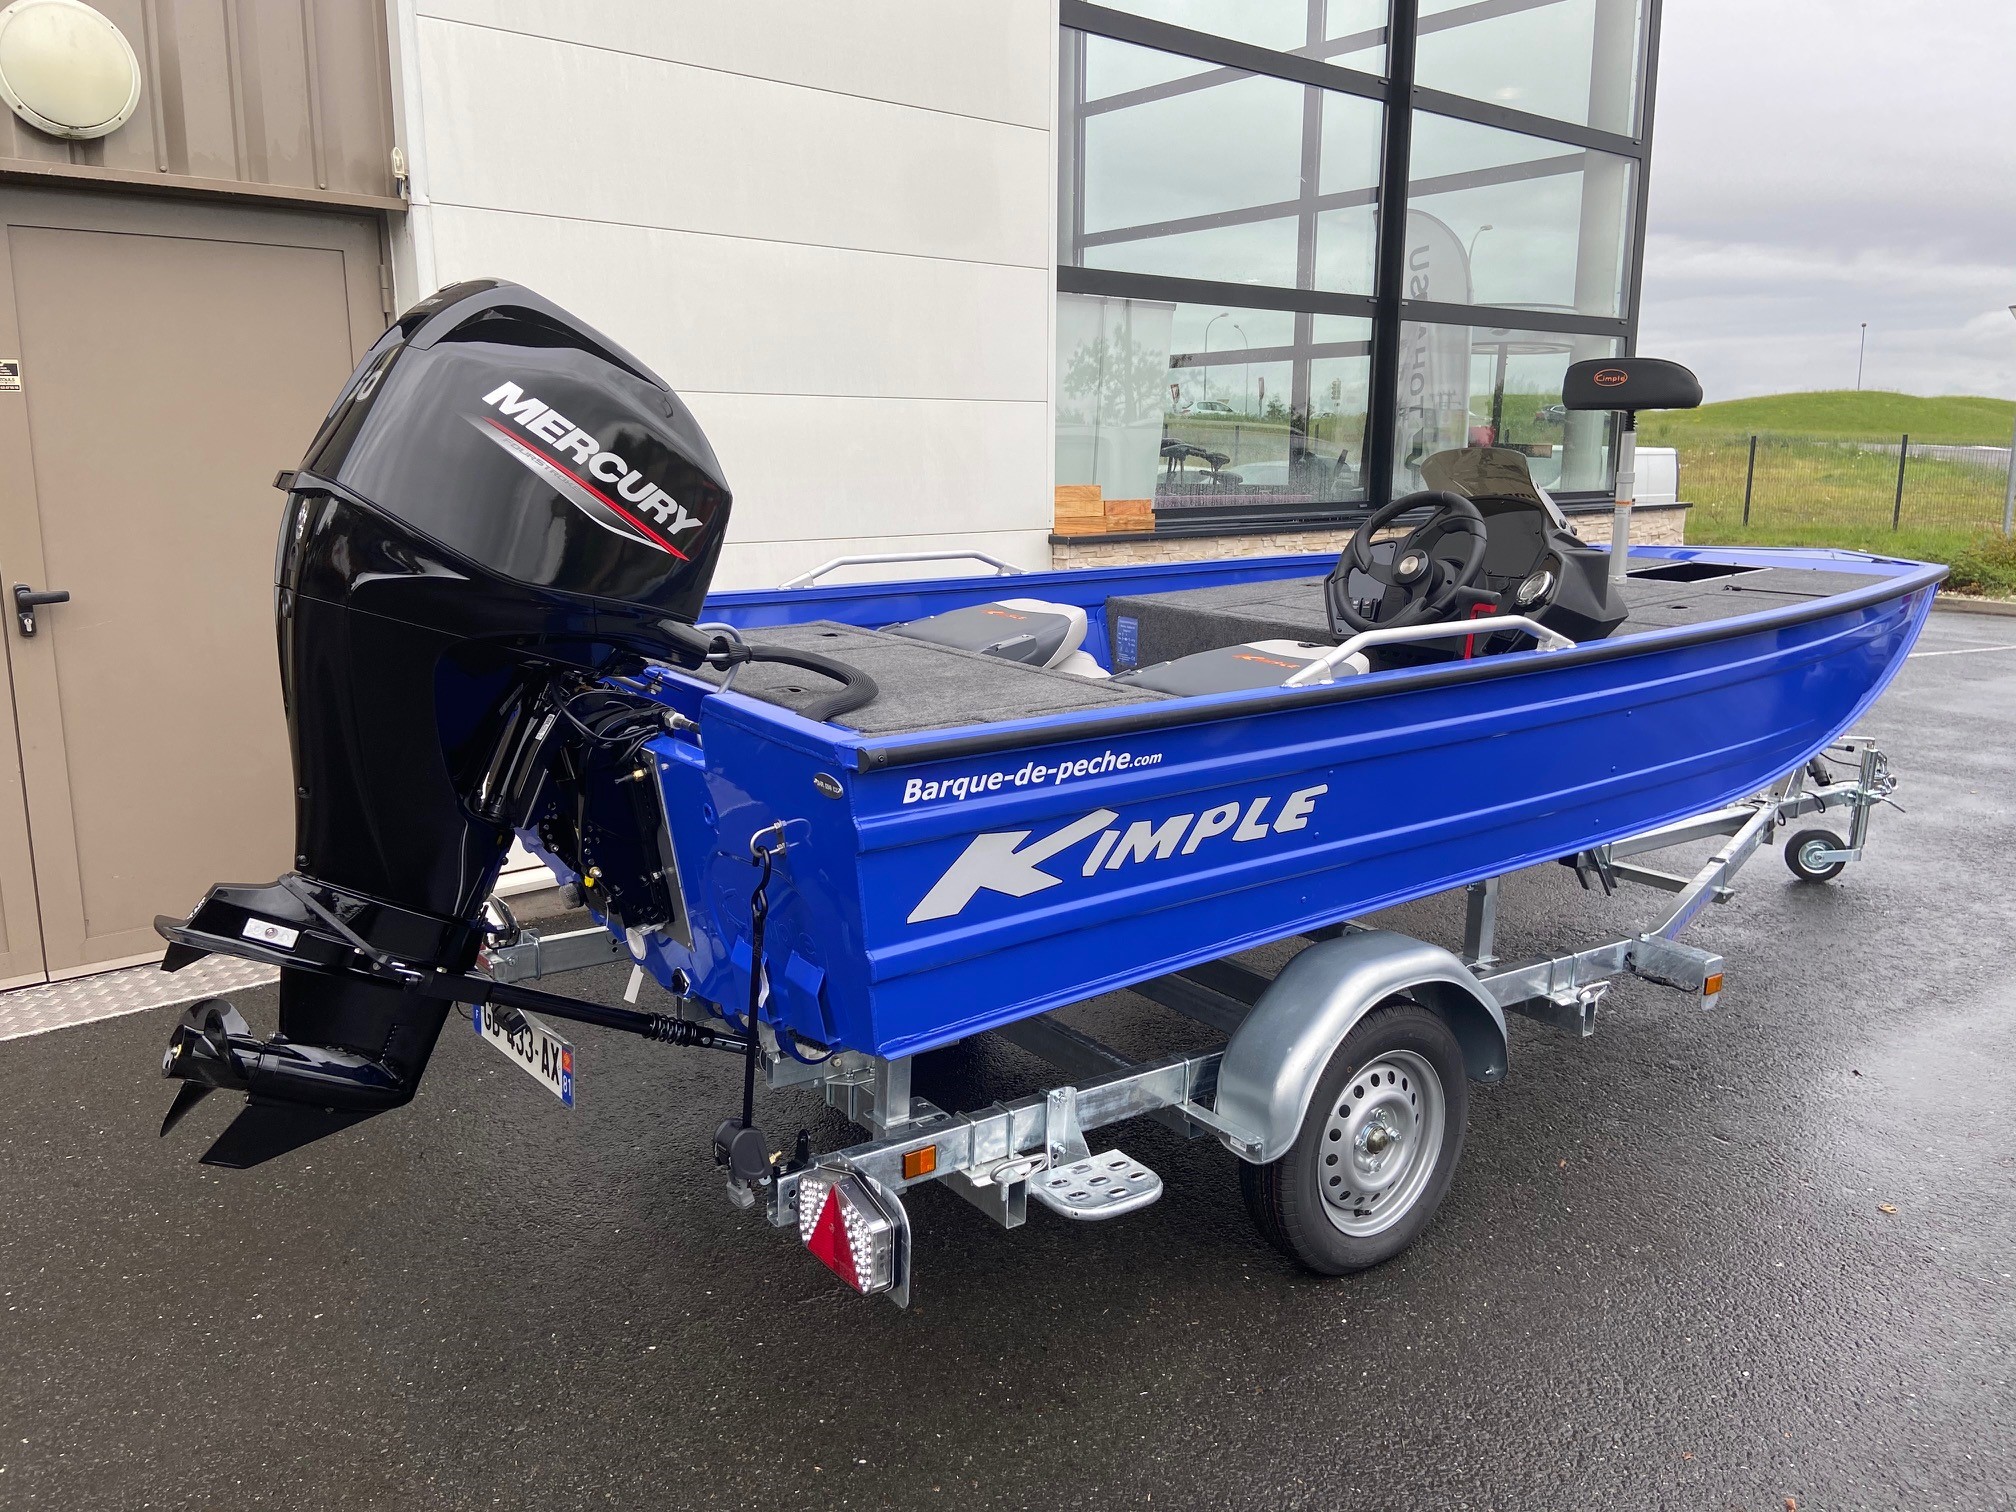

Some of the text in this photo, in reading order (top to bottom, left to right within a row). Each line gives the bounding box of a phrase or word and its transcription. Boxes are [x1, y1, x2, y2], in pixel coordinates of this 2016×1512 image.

[482, 380, 703, 535] MERCURY
[902, 749, 1163, 804] Barque-de-peche.com
[906, 784, 1329, 924] KIMPLE
